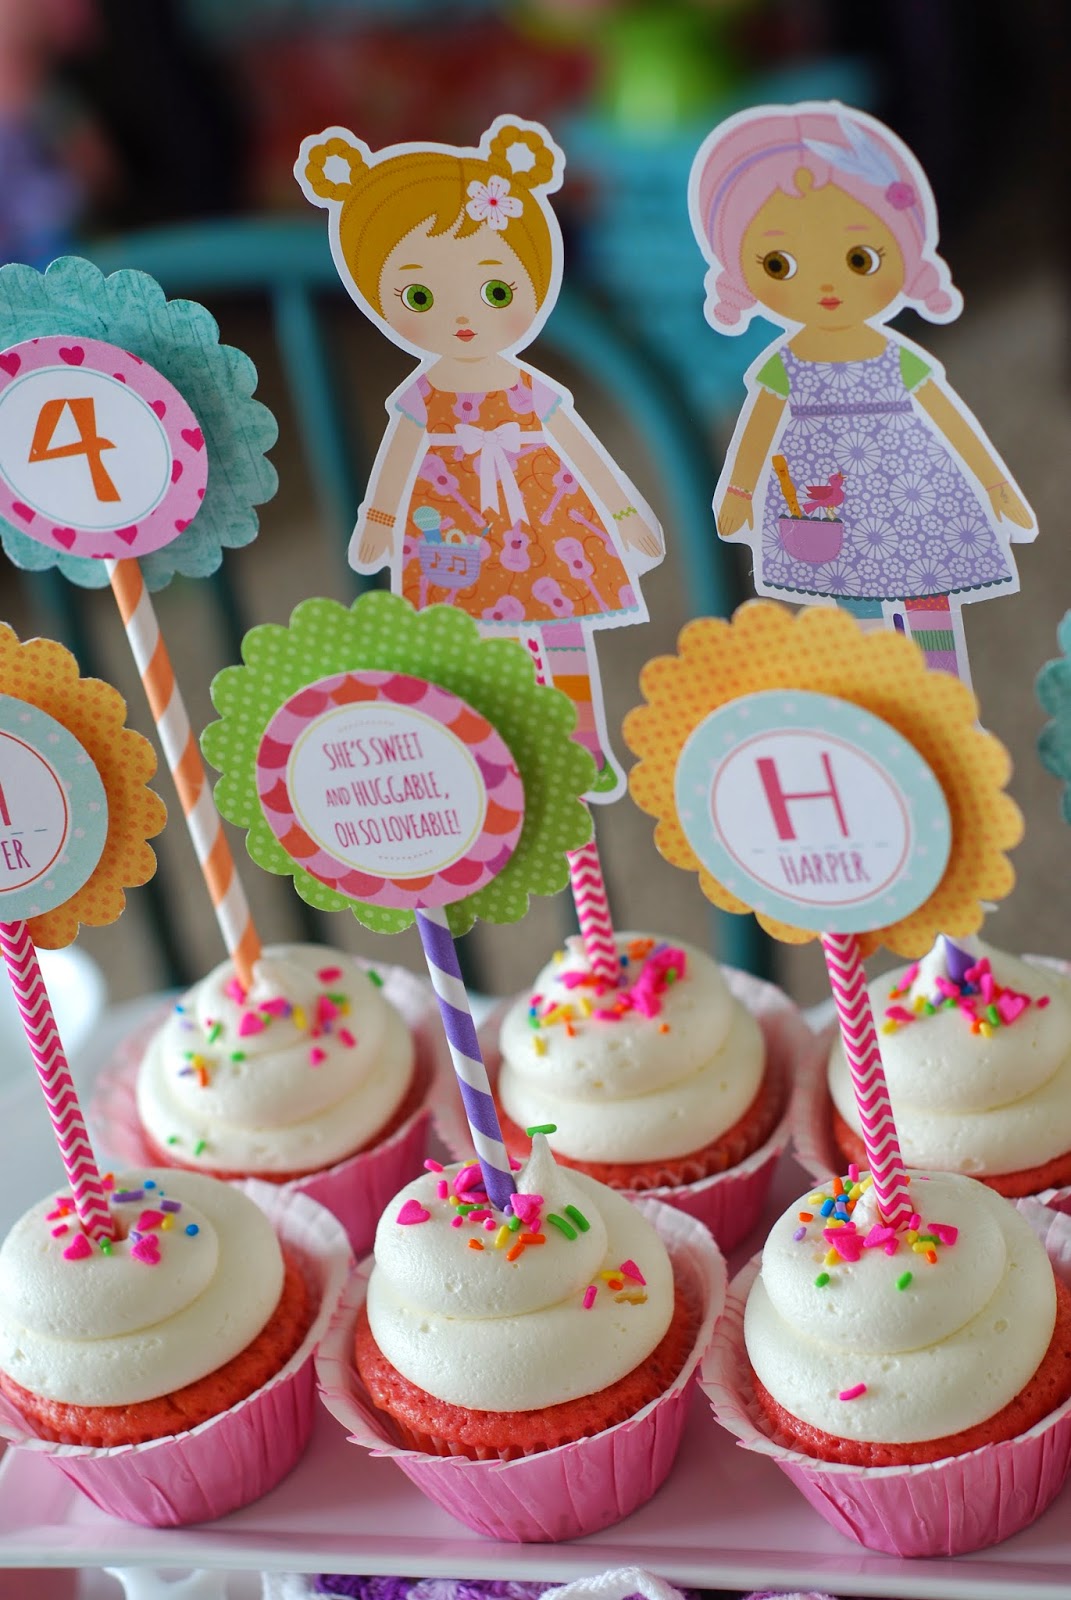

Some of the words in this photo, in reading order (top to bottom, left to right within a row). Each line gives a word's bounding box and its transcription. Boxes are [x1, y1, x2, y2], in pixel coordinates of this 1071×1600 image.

[28, 397, 121, 503] 4
[322, 738, 370, 771] SHE'S
[369, 732, 424, 765] SWEET
[325, 786, 351, 807] AND
[351, 771, 449, 806] HUGGABLE,
[755, 752, 849, 841] H
[334, 821, 360, 848] OH
[359, 818, 382, 845] SO
[381, 809, 462, 843] LOVEABLE!
[779, 850, 871, 885] HARPER
